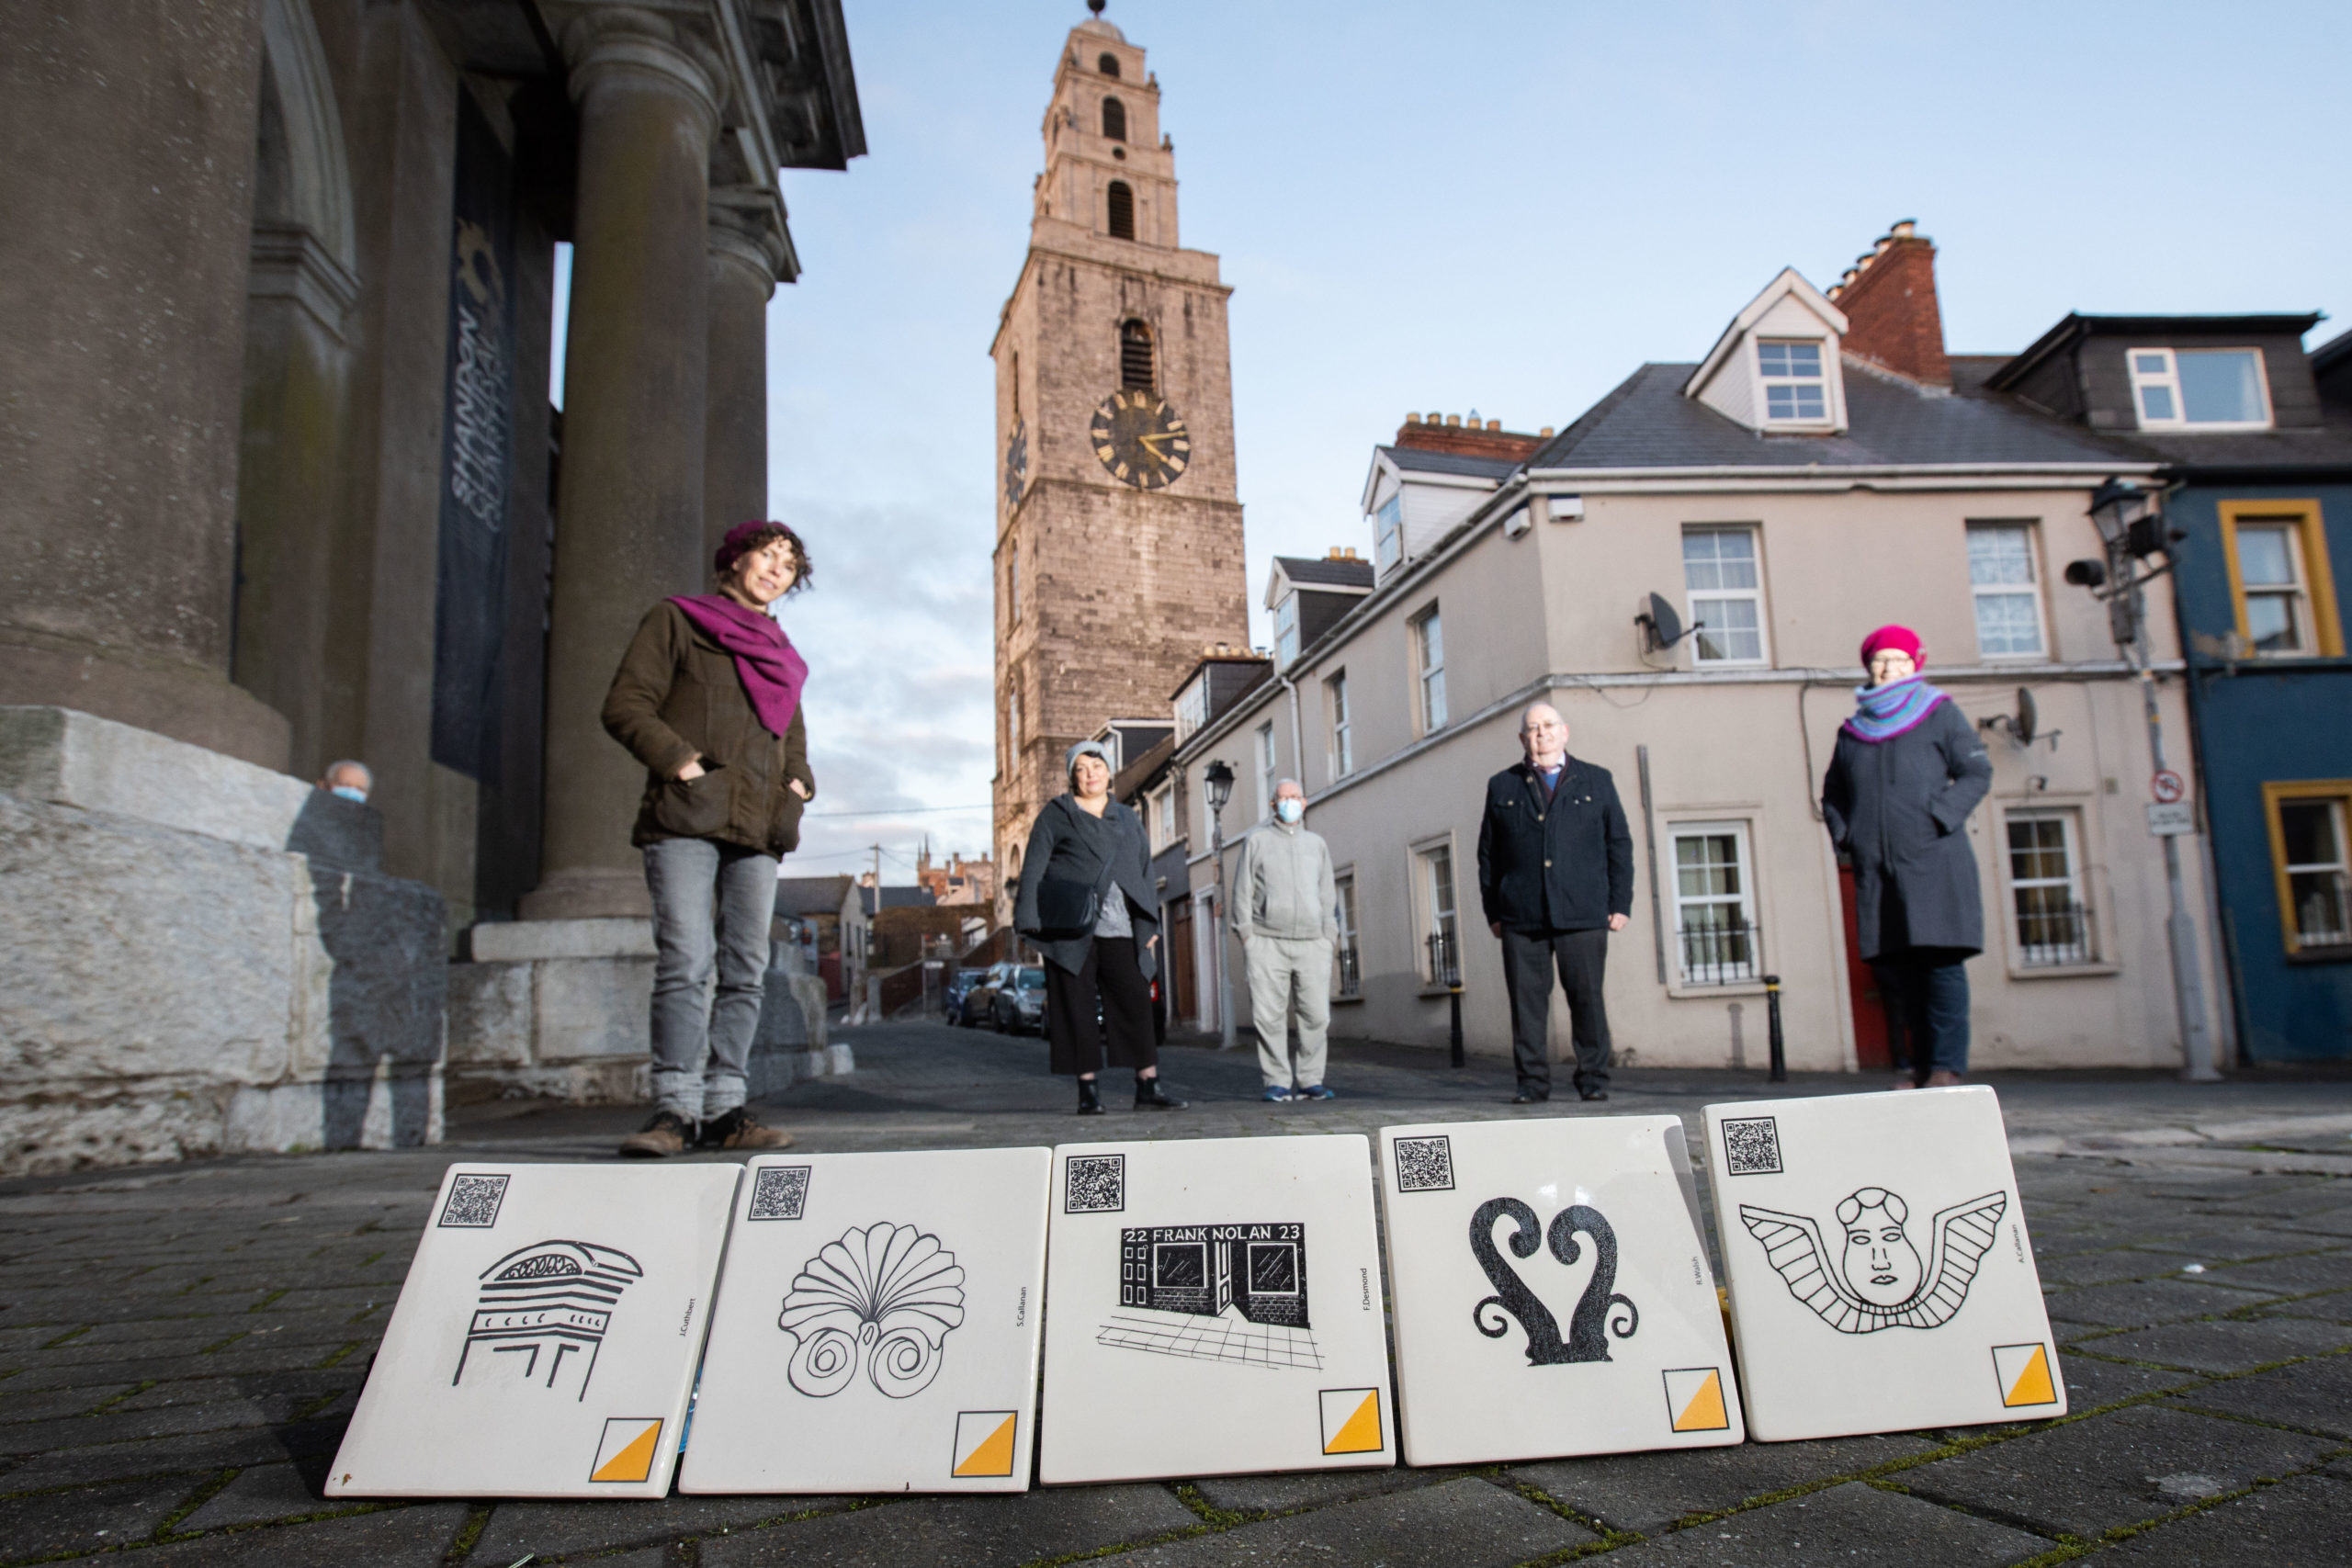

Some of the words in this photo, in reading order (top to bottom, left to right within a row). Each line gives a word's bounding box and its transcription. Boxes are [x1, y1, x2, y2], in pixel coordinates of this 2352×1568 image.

[452, 304, 479, 503] SHANDON
[466, 332, 501, 522] CULTURAL
[1125, 1230, 1148, 1242] 22
[1153, 1227, 1207, 1241] FRANK
[1212, 1225, 1271, 1240] NOLAN
[1279, 1224, 1300, 1239] 23
[2011, 1224, 2026, 1264] A.Callanan
[1360, 1268, 1371, 1312] F.Desmond
[1691, 1256, 1703, 1286] R.Walsh
[678, 1297, 696, 1337] J.Cuthbert
[1016, 1286, 1026, 1327] S.Callanan
